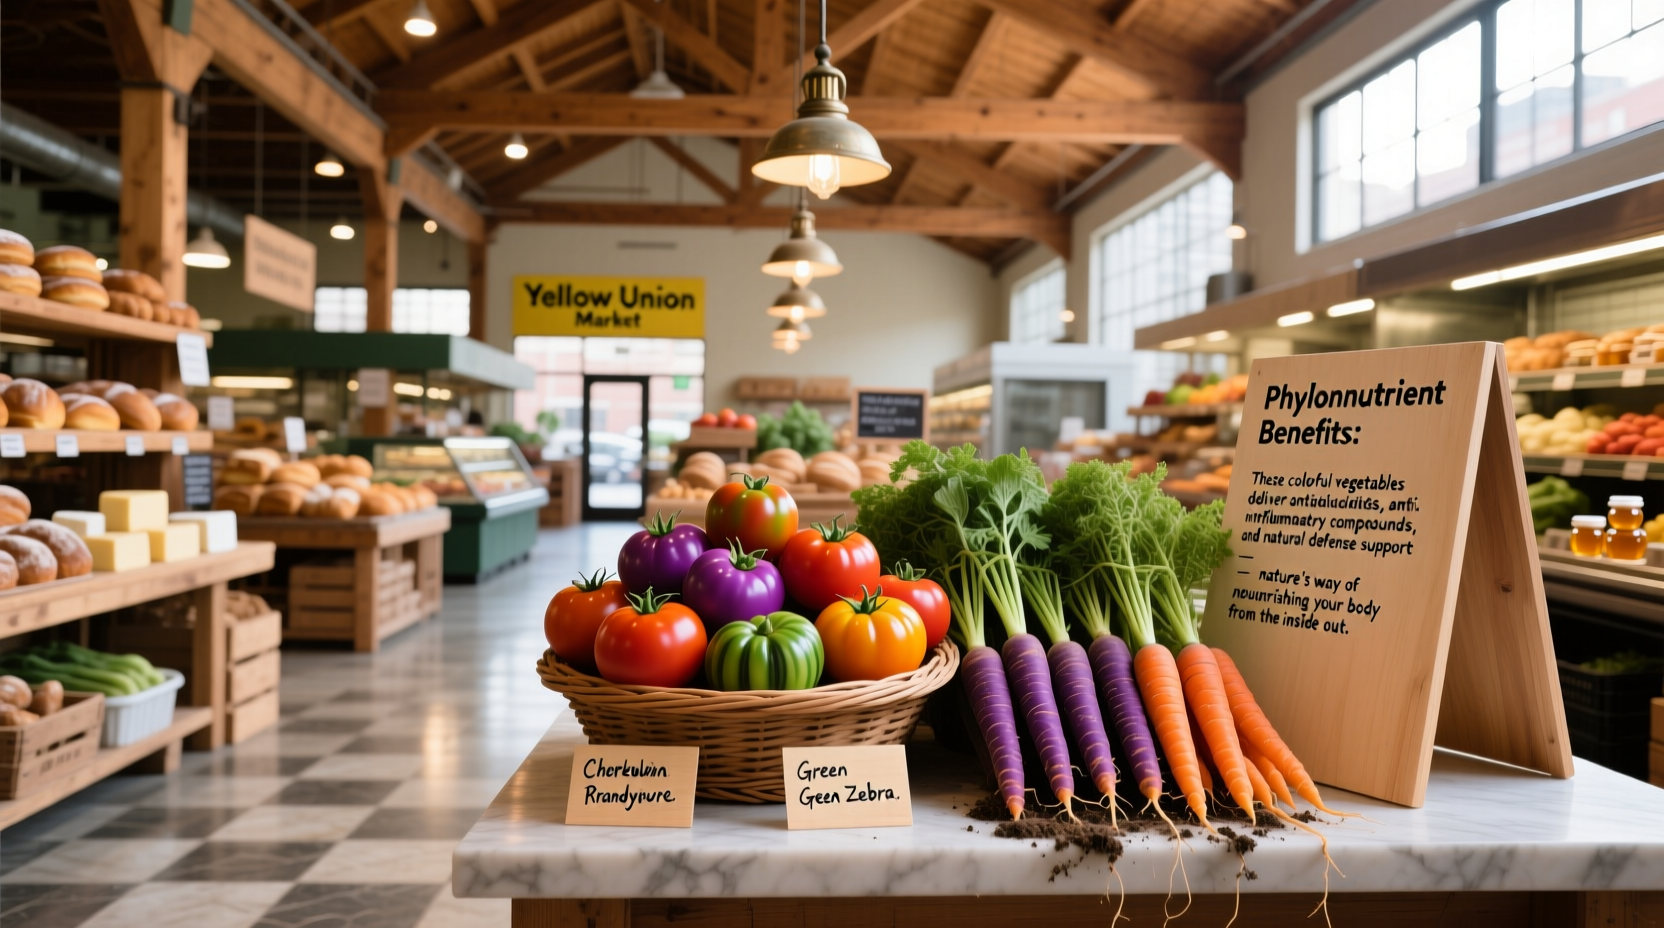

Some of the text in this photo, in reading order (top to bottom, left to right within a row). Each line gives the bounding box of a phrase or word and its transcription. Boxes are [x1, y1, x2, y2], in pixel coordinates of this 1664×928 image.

[524, 283, 695, 309] Yellow Union
[576, 311, 641, 328] Market
[1264, 379, 1446, 417] Phylonnutrient
[1259, 418, 1361, 445] Benefits:
[1252, 471, 1284, 486] These
[1336, 474, 1405, 493] vegetables
[1248, 491, 1287, 505] deliver
[1241, 528, 1413, 557] and natural defense support
[1259, 569, 1310, 586] nature's
[1314, 577, 1341, 593] way
[1345, 577, 1360, 592] of
[1228, 604, 1349, 634] from the inside out.
[1314, 598, 1343, 611] your
[1347, 597, 1381, 622] body
[797, 760, 847, 782] Green
[800, 782, 900, 810] Geen Zebra.
